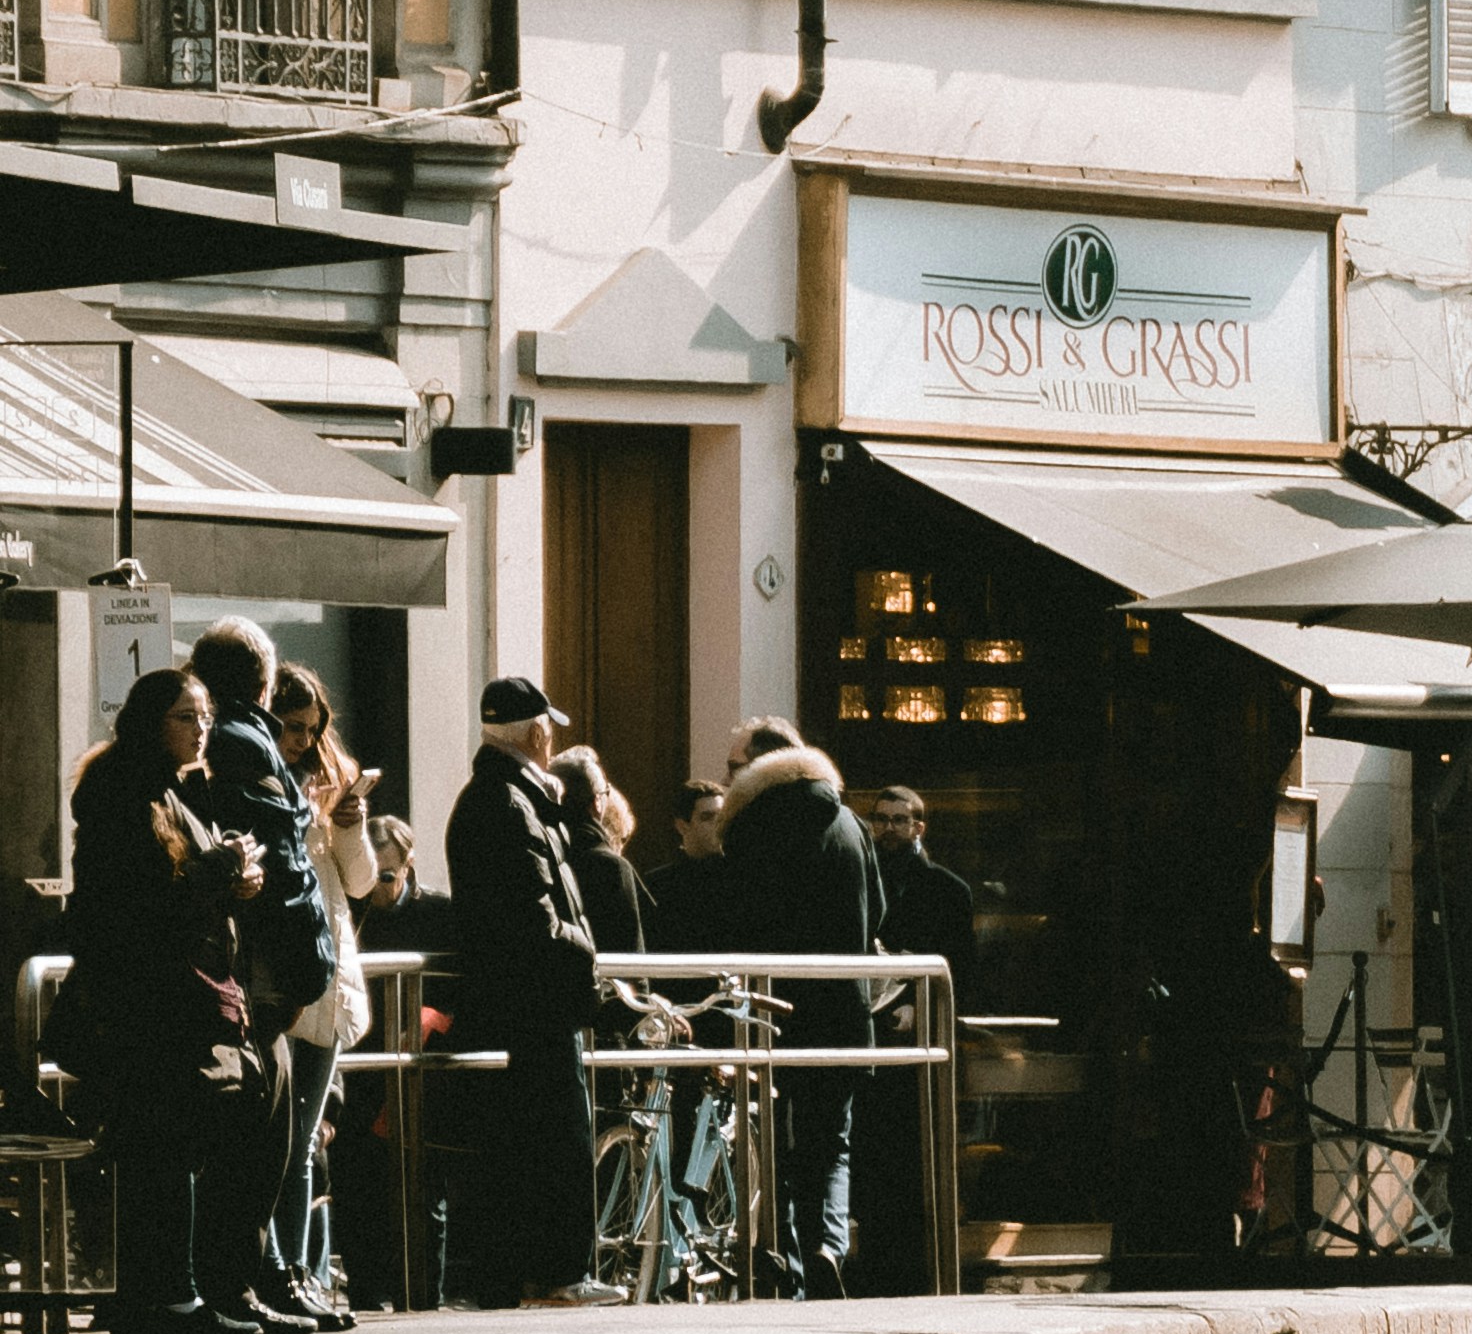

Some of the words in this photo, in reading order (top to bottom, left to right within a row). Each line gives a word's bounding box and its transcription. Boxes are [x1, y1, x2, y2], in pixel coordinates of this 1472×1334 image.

[923, 302, 1043, 394] ROSSI
[1063, 330, 1086, 372] &
[1101, 315, 1252, 402] GRASSI
[1039, 379, 1139, 416] SALUMIERI
[111, 598, 139, 609] LINEA
[141, 598, 150, 608] IN
[104, 613, 159, 625] DEVIAZIONE
[127, 638, 140, 676] 1
[101, 701, 123, 713] Grec
